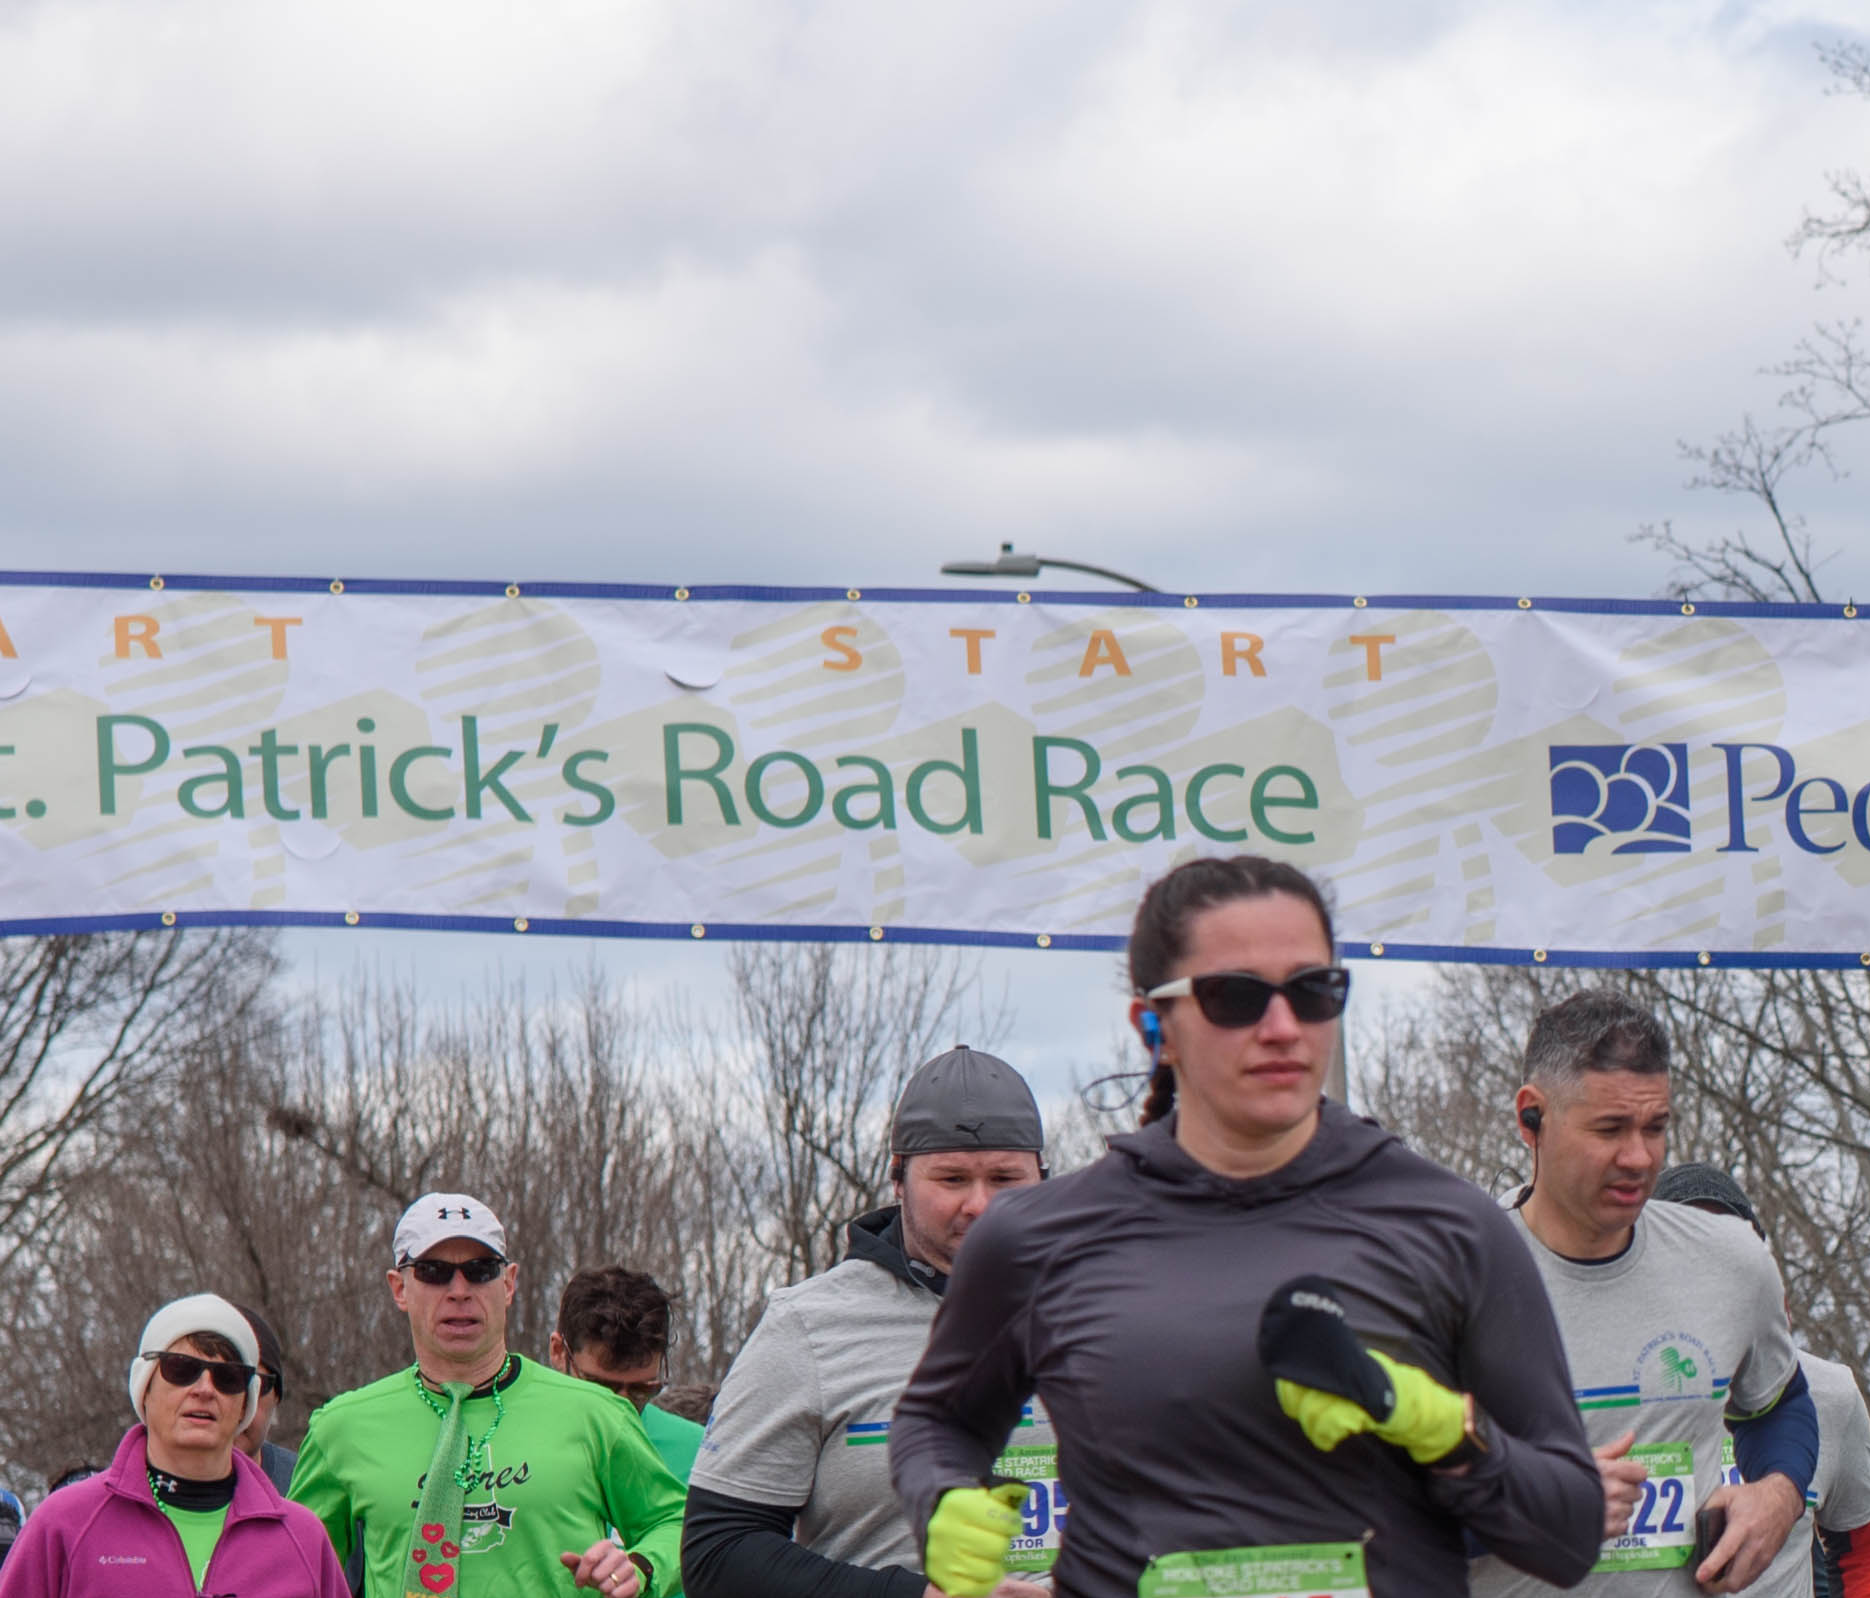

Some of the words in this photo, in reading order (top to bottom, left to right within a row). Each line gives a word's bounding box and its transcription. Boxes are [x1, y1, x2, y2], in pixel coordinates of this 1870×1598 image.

[819, 625, 1397, 683] START
[95, 713, 617, 828] Patrick's
[661, 722, 985, 836] Road
[1031, 734, 1320, 846] Race
[1631, 1477, 1685, 1535] 22
[1010, 1538, 1044, 1549] STOR
[1614, 1536, 1647, 1548] JOSE
